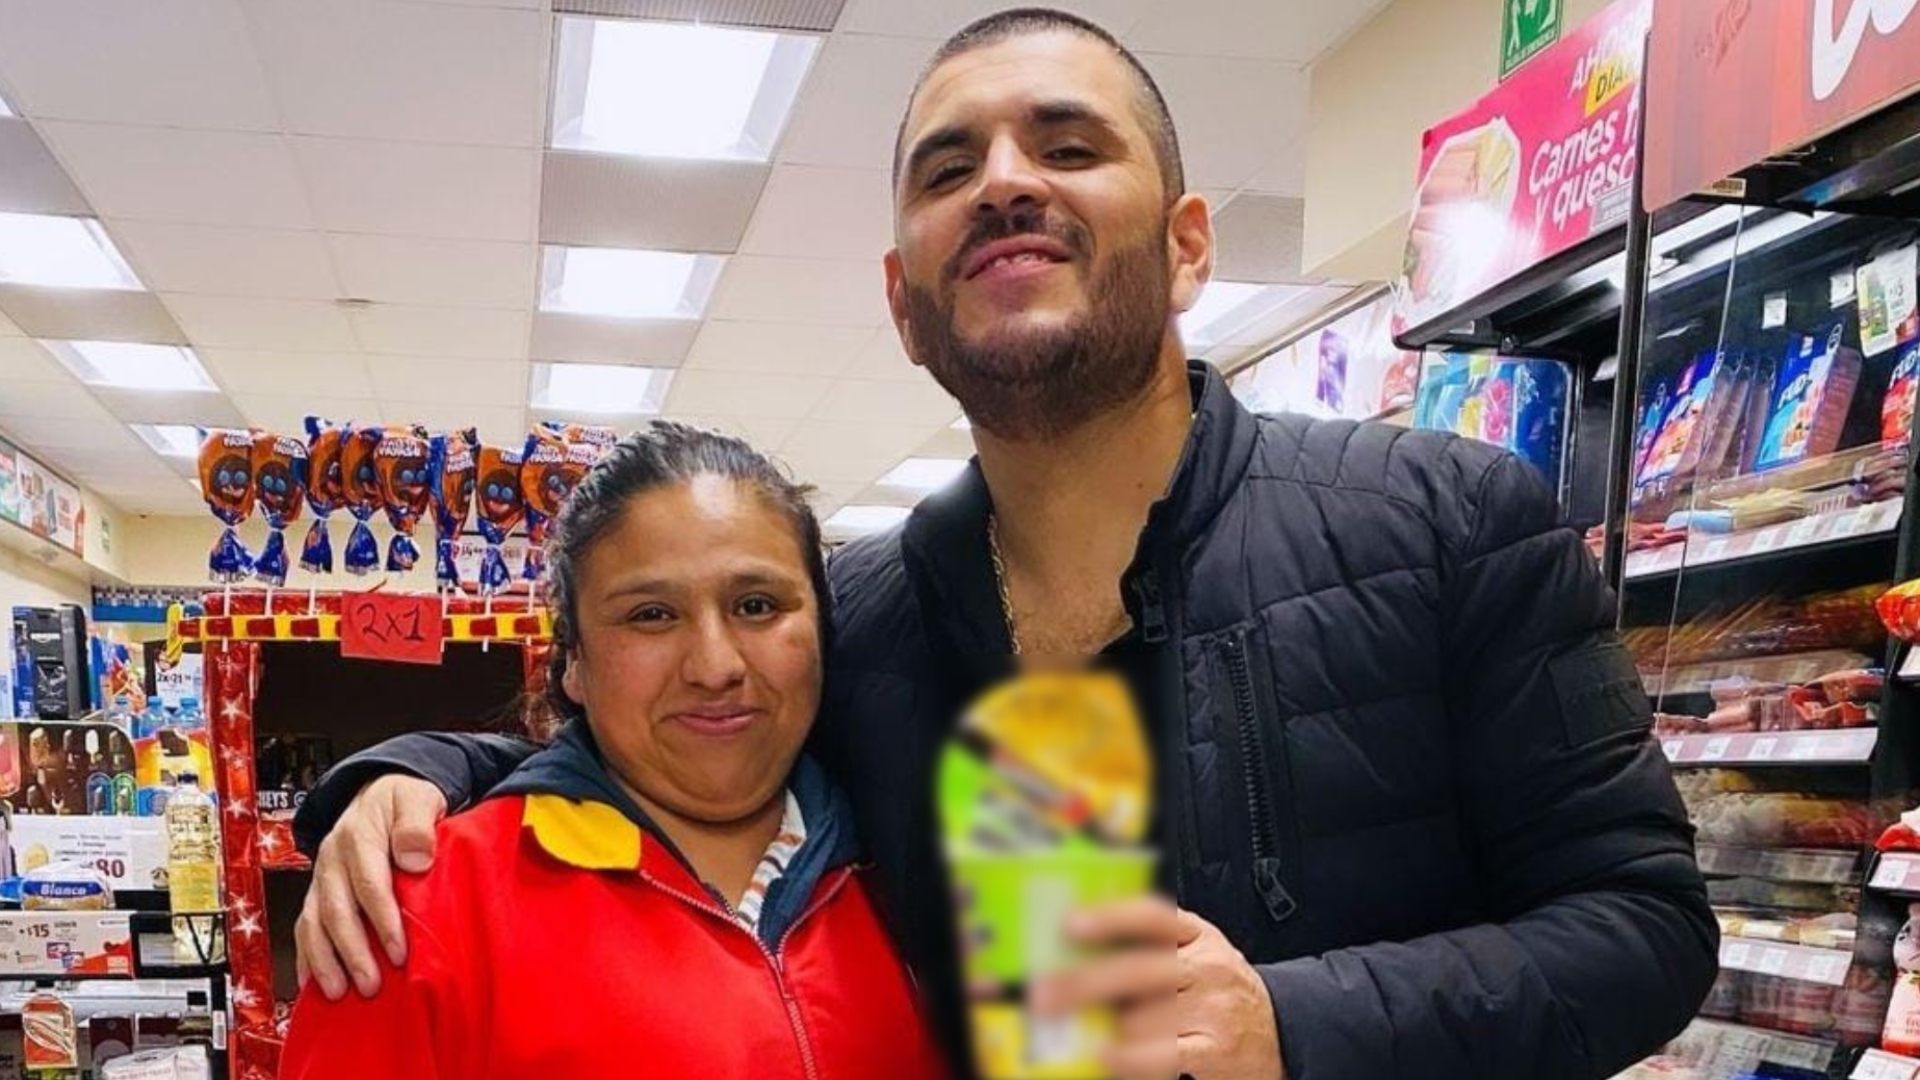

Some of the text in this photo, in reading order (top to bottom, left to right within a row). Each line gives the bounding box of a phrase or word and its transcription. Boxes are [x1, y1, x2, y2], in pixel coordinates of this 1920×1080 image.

[1528, 110, 1620, 196] Carnes
[356, 602, 425, 643] 2x1
[40, 883, 88, 897] Blanco
